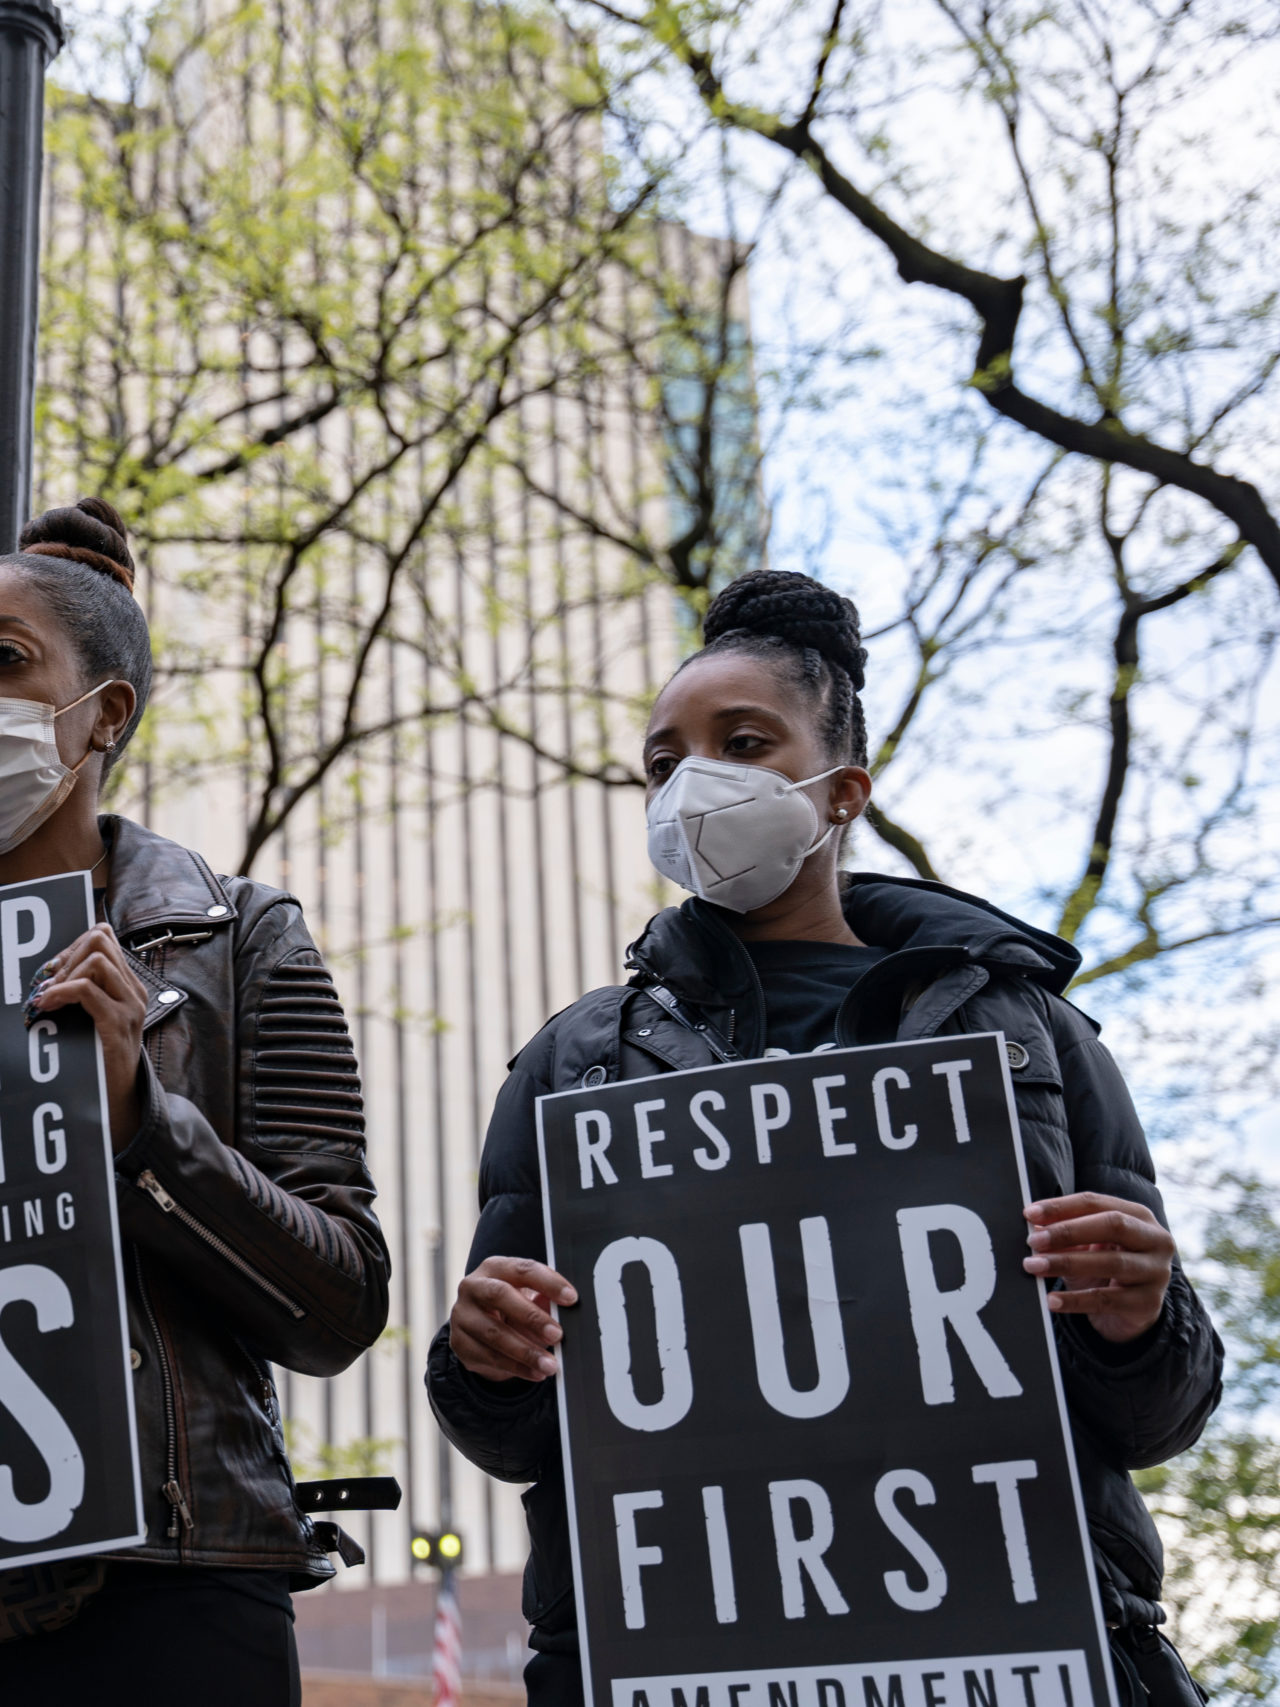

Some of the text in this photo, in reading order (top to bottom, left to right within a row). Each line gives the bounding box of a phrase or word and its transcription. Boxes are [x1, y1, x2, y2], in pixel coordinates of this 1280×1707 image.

[574, 1059, 972, 1190] RESPECT
[593, 1203, 1023, 1432] OUR
[612, 1459, 1038, 1630] FIRST
